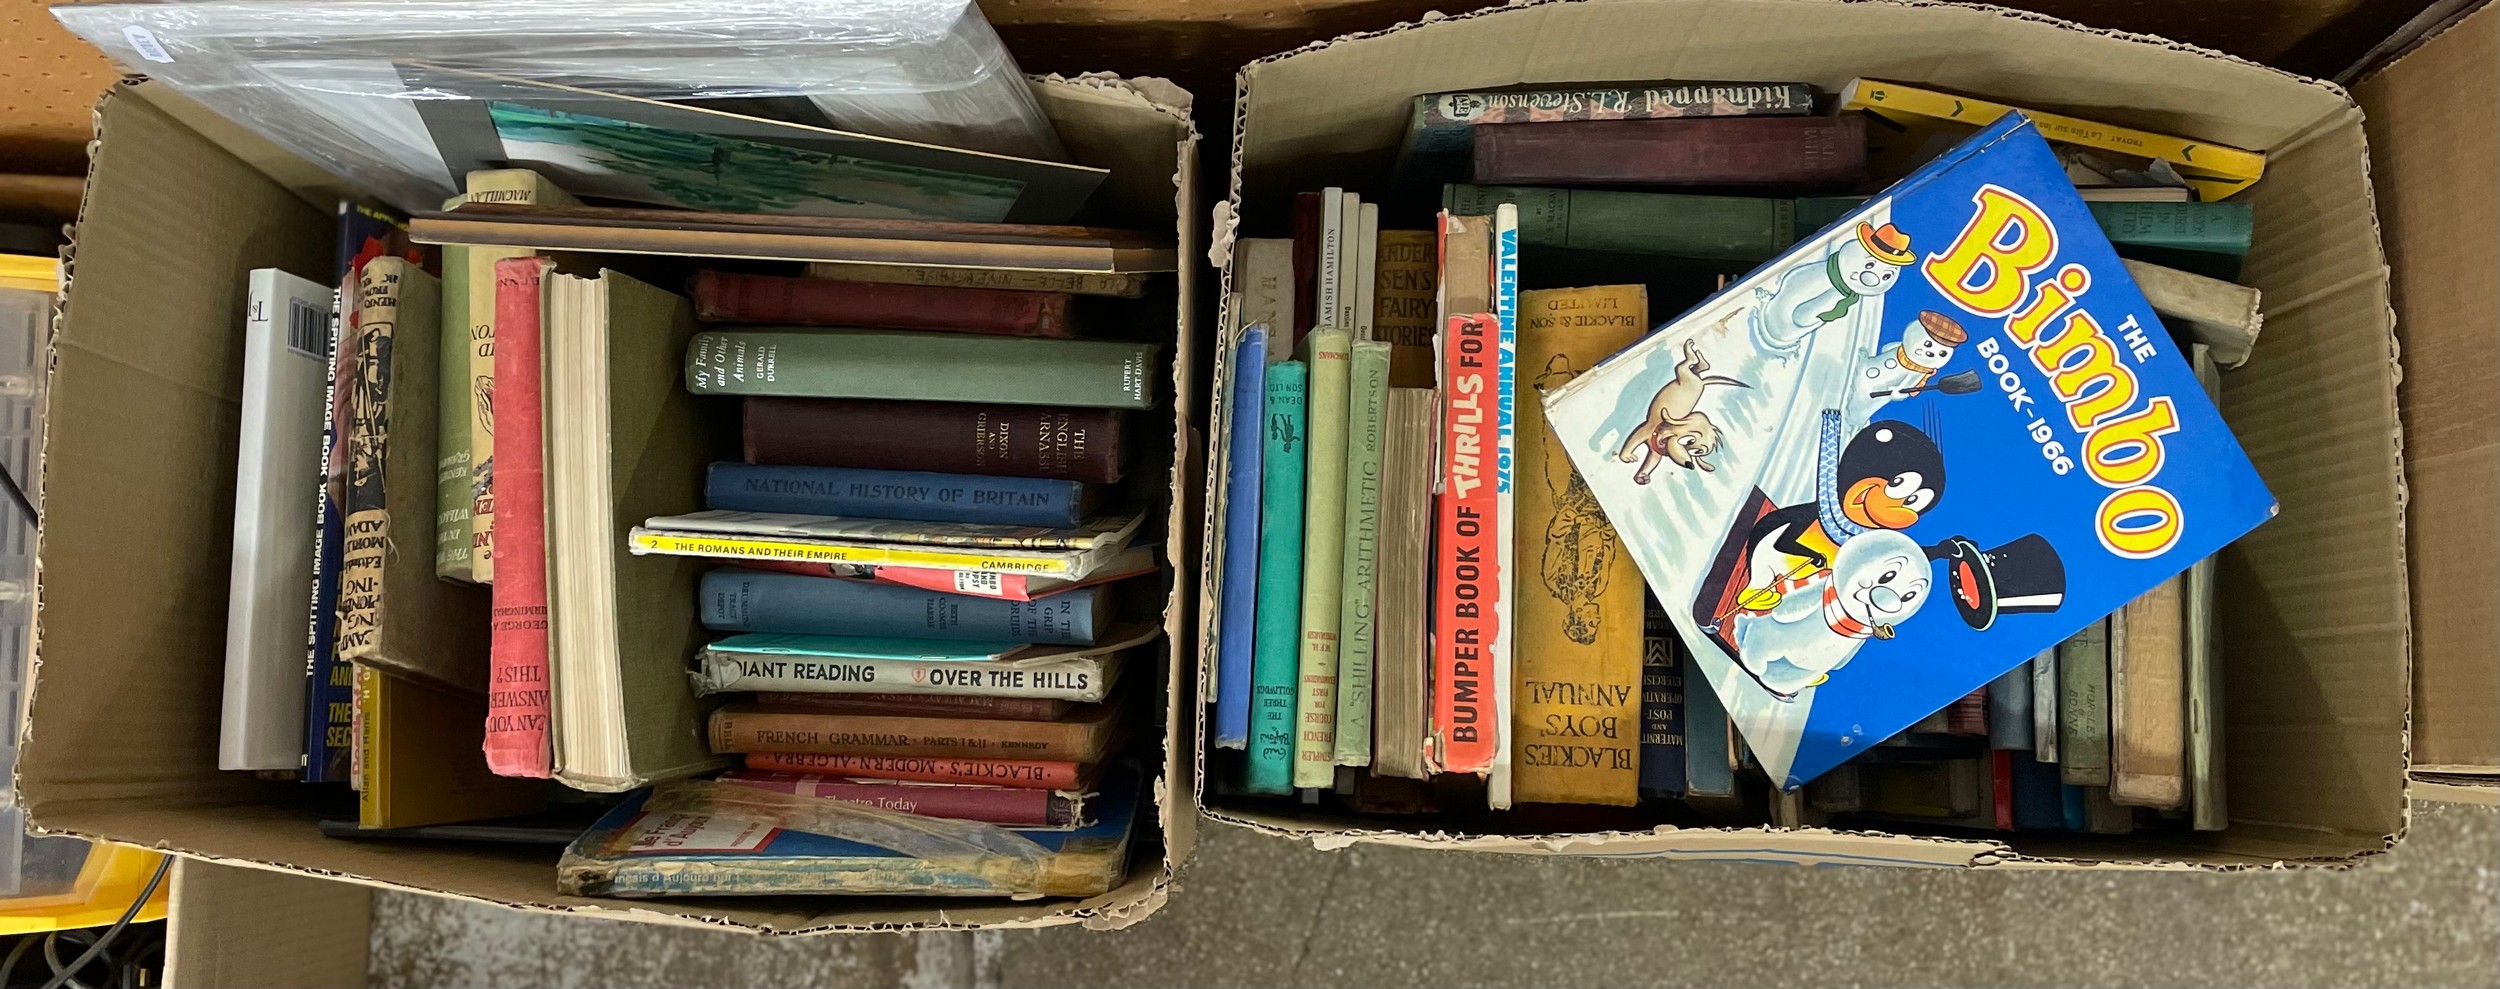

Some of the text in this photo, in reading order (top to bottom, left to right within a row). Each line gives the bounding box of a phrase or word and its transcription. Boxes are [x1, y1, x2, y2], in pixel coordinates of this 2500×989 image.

[1646, 85, 1791, 110] Kidnapped
[1325, 227, 1336, 286] HAMILTON
[1375, 299, 1433, 319] FAIRY
[1547, 297, 1619, 311] LIMITED
[1530, 315, 1635, 330] BLACKIE & SON
[2116, 312, 2159, 366] THE
[695, 334, 714, 389] My Family
[713, 336, 729, 387] and Other
[733, 340, 747, 383] Animals
[756, 345, 766, 379] GERALD
[767, 343, 777, 382] DURRELL
[1123, 358, 1133, 392] RUPERT
[1497, 228, 1518, 495] VALENTINE ANNUAL 1975
[1921, 182, 2185, 560] Bimbo
[319, 286, 342, 477] THE SPITTING IMAGE BOOK
[1133, 351, 1144, 401] HART-DAVIS
[1285, 383, 1303, 393] SON
[1278, 395, 1303, 405] DEAN
[1365, 368, 1379, 453] ROBERTSON
[988, 431, 997, 450] AND
[999, 421, 1010, 460] DIXON
[1073, 428, 1087, 460] THE
[744, 478, 1051, 507] NATIONAL HISTORY OF BRITAIN
[1355, 460, 1378, 591] ARITHMETIC
[1452, 321, 1484, 743] BUMPER BOOK OF THRILLS FOR
[650, 540, 848, 561] 2 THE ROMANS AND THEIR EMPIRE
[305, 482, 328, 679] THE SPITTING IMAGE BOOK
[981, 560, 1050, 574] CAMBRIDGE
[717, 592, 726, 620] DEPOT
[500, 620, 549, 631] GEORGE
[1043, 606, 1055, 635] GRIP
[1060, 600, 1072, 640] IN THE
[496, 664, 542, 684] THIS?
[793, 661, 876, 683] READING
[929, 668, 983, 687] OVER
[987, 670, 1025, 689] THE
[1032, 671, 1090, 691] HILLS
[489, 689, 550, 709] ANSWER
[1263, 698, 1288, 708] THREE
[1311, 687, 1329, 697] FIRST
[1525, 680, 1632, 707] ANNUAL
[328, 702, 352, 724] THE
[488, 714, 513, 733] YOU
[1266, 711, 1283, 721] THE
[1304, 712, 1332, 724] COURSE
[1350, 715, 1365, 729] A
[756, 730, 819, 745] FRENCH
[828, 731, 911, 747] GRAMMAR
[922, 736, 959, 748] PARTS
[1303, 731, 1332, 743] FRENCH
[1640, 733, 1684, 747] MATERNIT
[1651, 723, 1669, 731] AND
[361, 711, 371, 802] Allan and Harris
[773, 751, 1046, 780] BLACKIE'S MODERN ALGEBRA
[1262, 747, 1287, 761] Enid
[1301, 751, 1333, 763] SIMPLER
[1524, 743, 1633, 770] BLACKIE'S
[876, 798, 918, 814] Today
